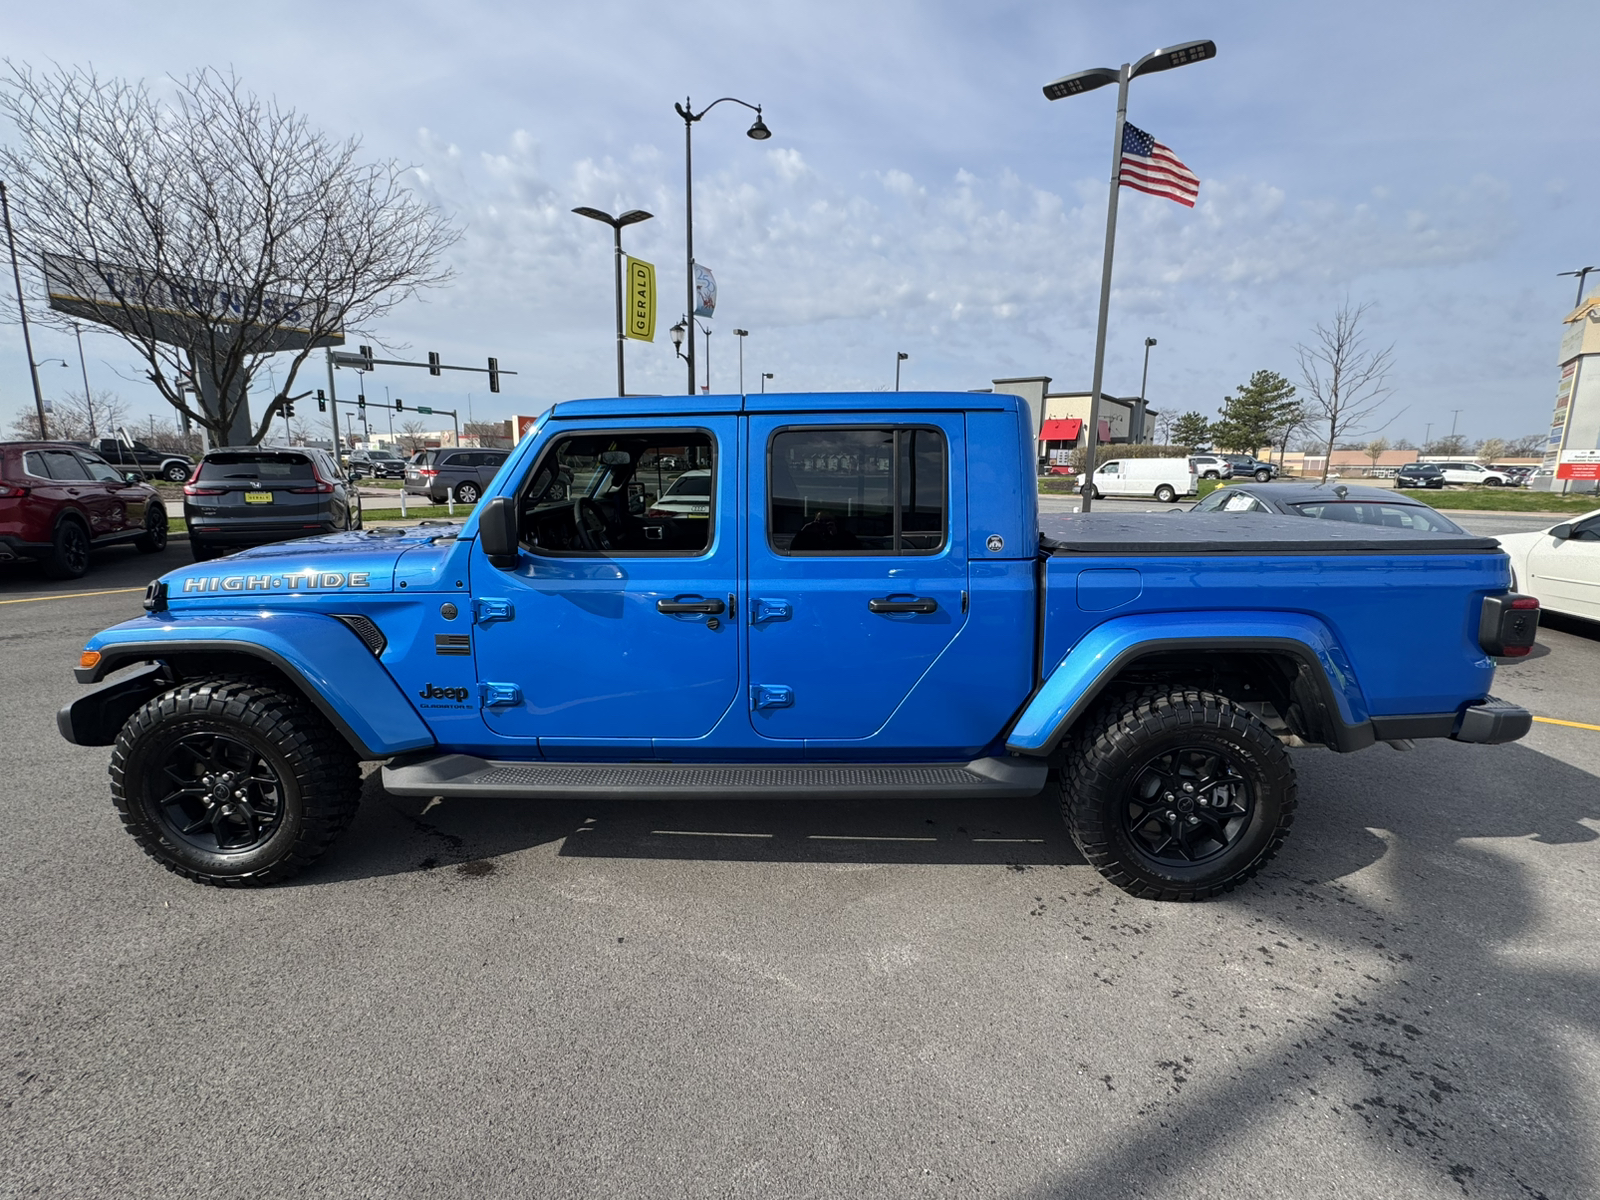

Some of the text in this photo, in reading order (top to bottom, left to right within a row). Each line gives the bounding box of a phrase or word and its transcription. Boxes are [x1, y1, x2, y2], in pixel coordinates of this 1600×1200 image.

[695, 268, 716, 293] 250
[636, 269, 646, 330] GERALD
[418, 682, 469, 702] Jeep
